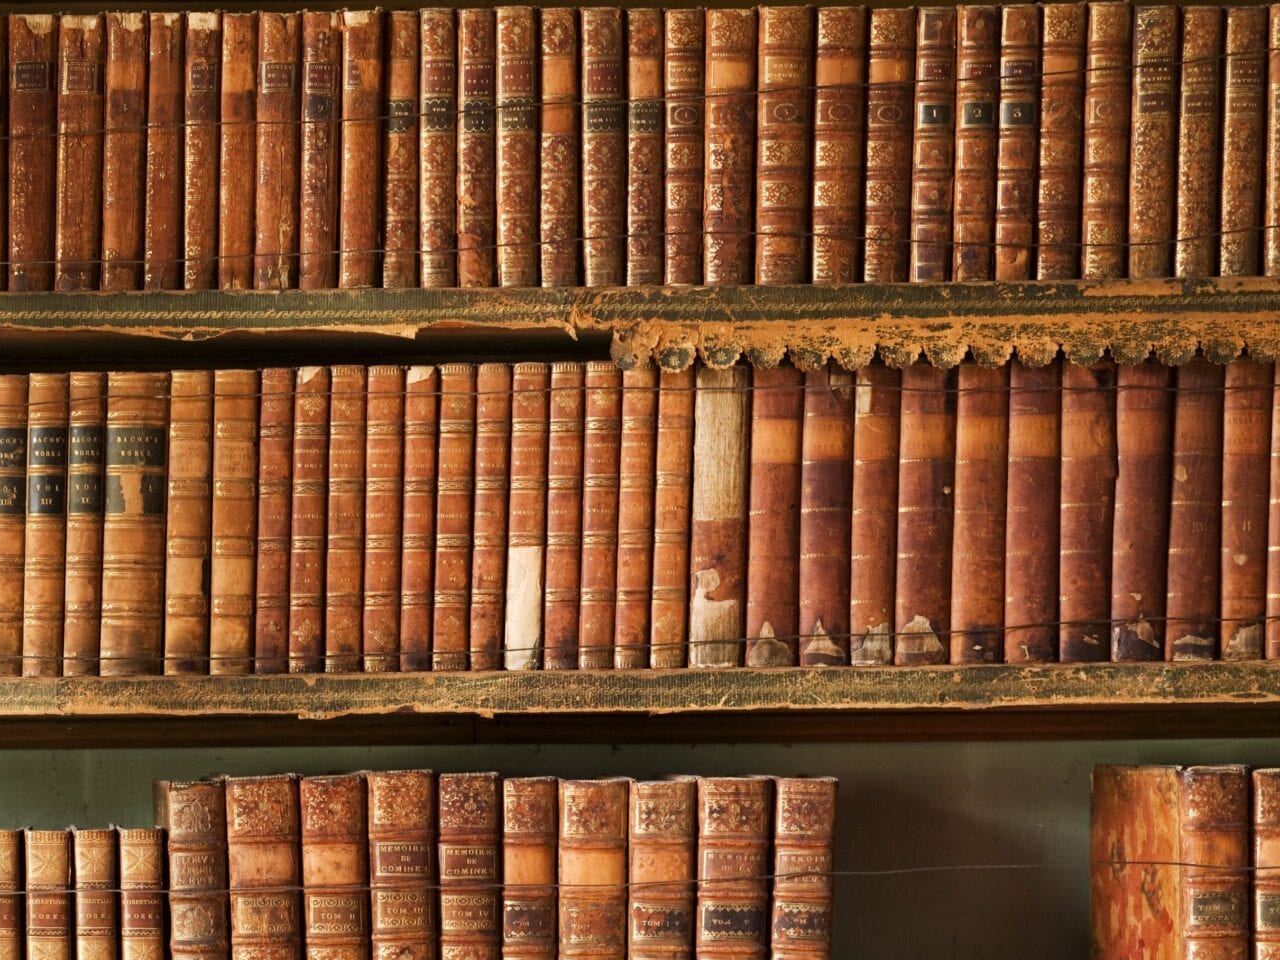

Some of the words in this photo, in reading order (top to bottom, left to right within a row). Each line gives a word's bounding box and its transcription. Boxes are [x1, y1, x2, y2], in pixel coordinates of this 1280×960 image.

[973, 108, 982, 118] 2
[387, 907, 406, 915] TOM
[451, 910, 472, 918] TOM
